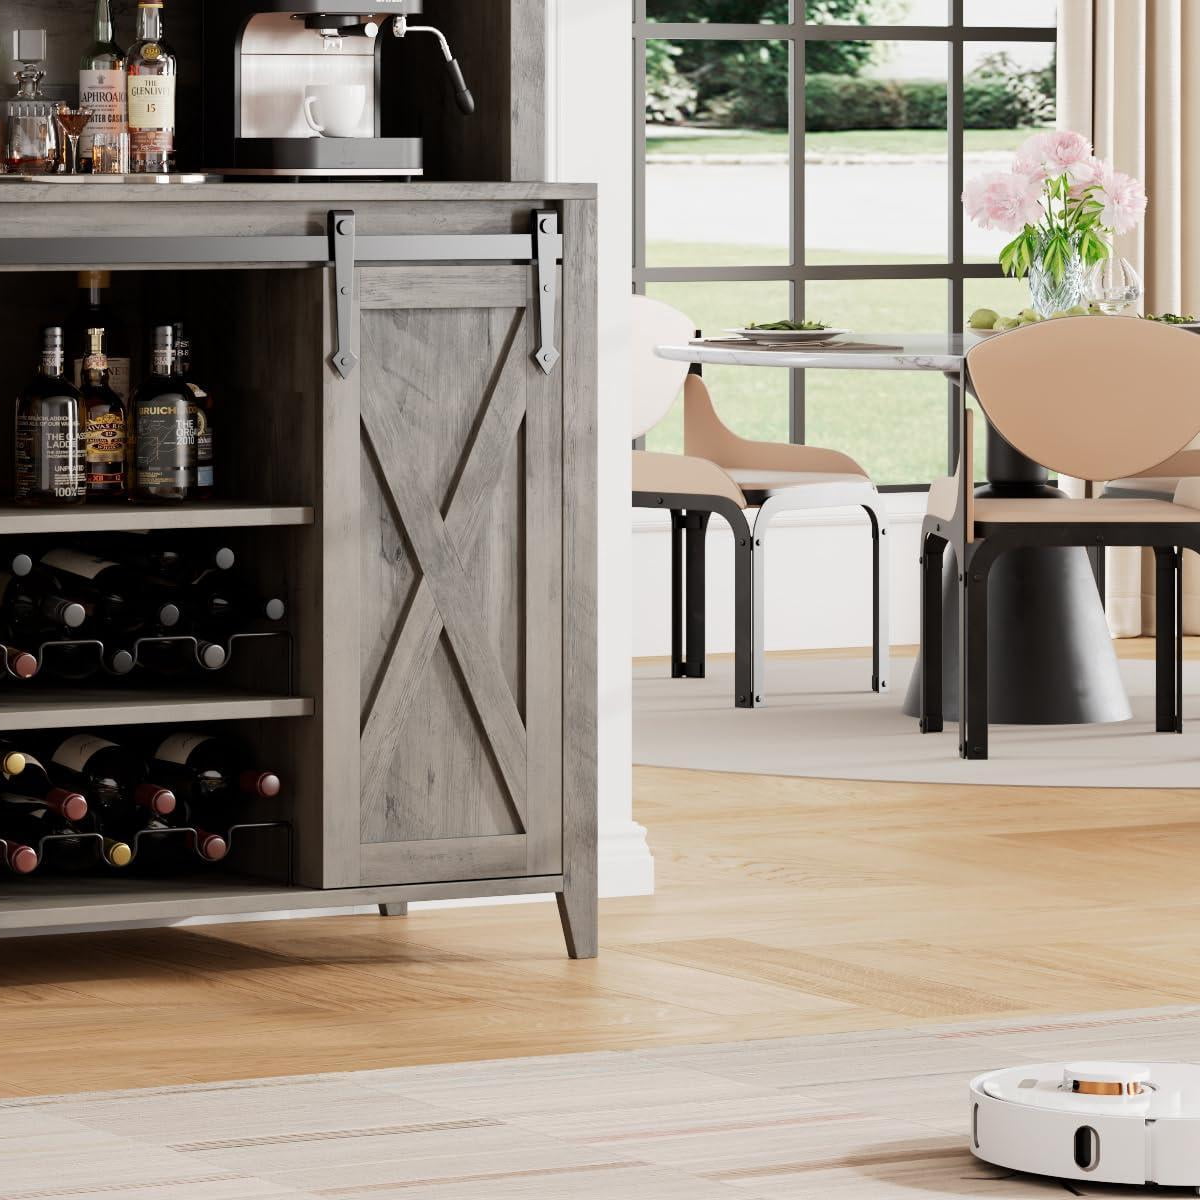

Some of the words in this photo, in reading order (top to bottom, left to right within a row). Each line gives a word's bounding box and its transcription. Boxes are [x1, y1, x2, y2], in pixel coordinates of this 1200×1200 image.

[146, 103, 156, 113] 15
[176, 419, 194, 429] THE
[47, 433, 65, 441] THE
[176, 437, 195, 446] 2010
